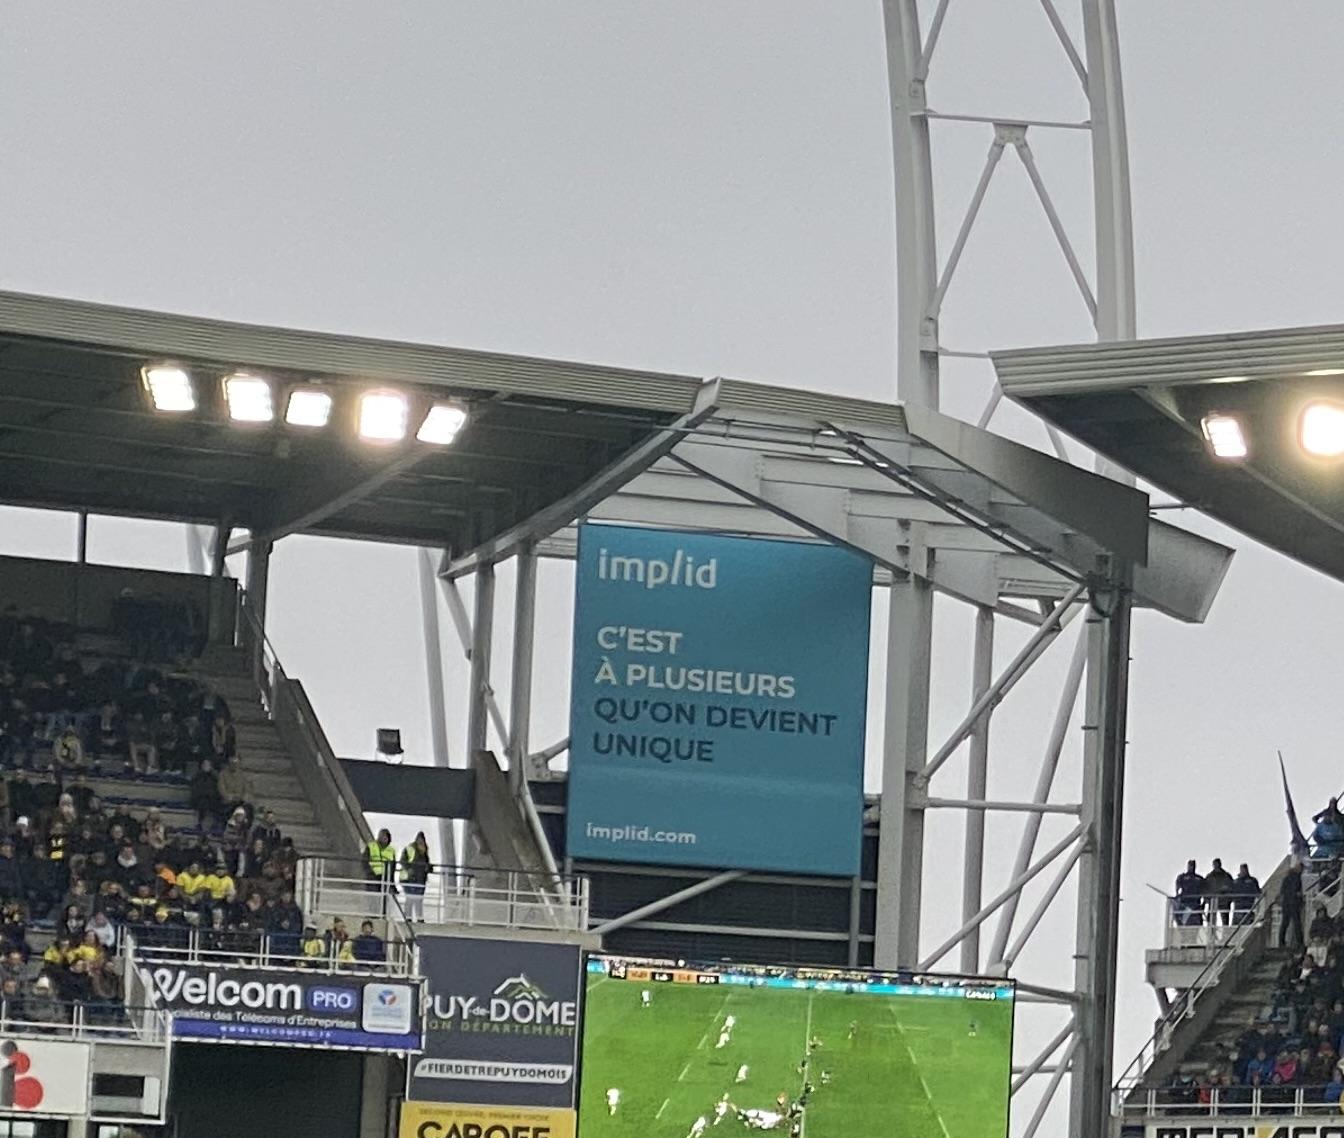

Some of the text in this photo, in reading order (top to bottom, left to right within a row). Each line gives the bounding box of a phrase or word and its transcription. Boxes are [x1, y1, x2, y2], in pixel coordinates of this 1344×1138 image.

[597, 626, 683, 655] C'EST
[595, 656, 796, 699] À PLUSIEURS
[594, 697, 837, 737] QU'ON DEVIENT
[593, 734, 714, 763] UNIQUE
[586, 823, 696, 845] implid.com
[313, 989, 352, 1009] PRO
